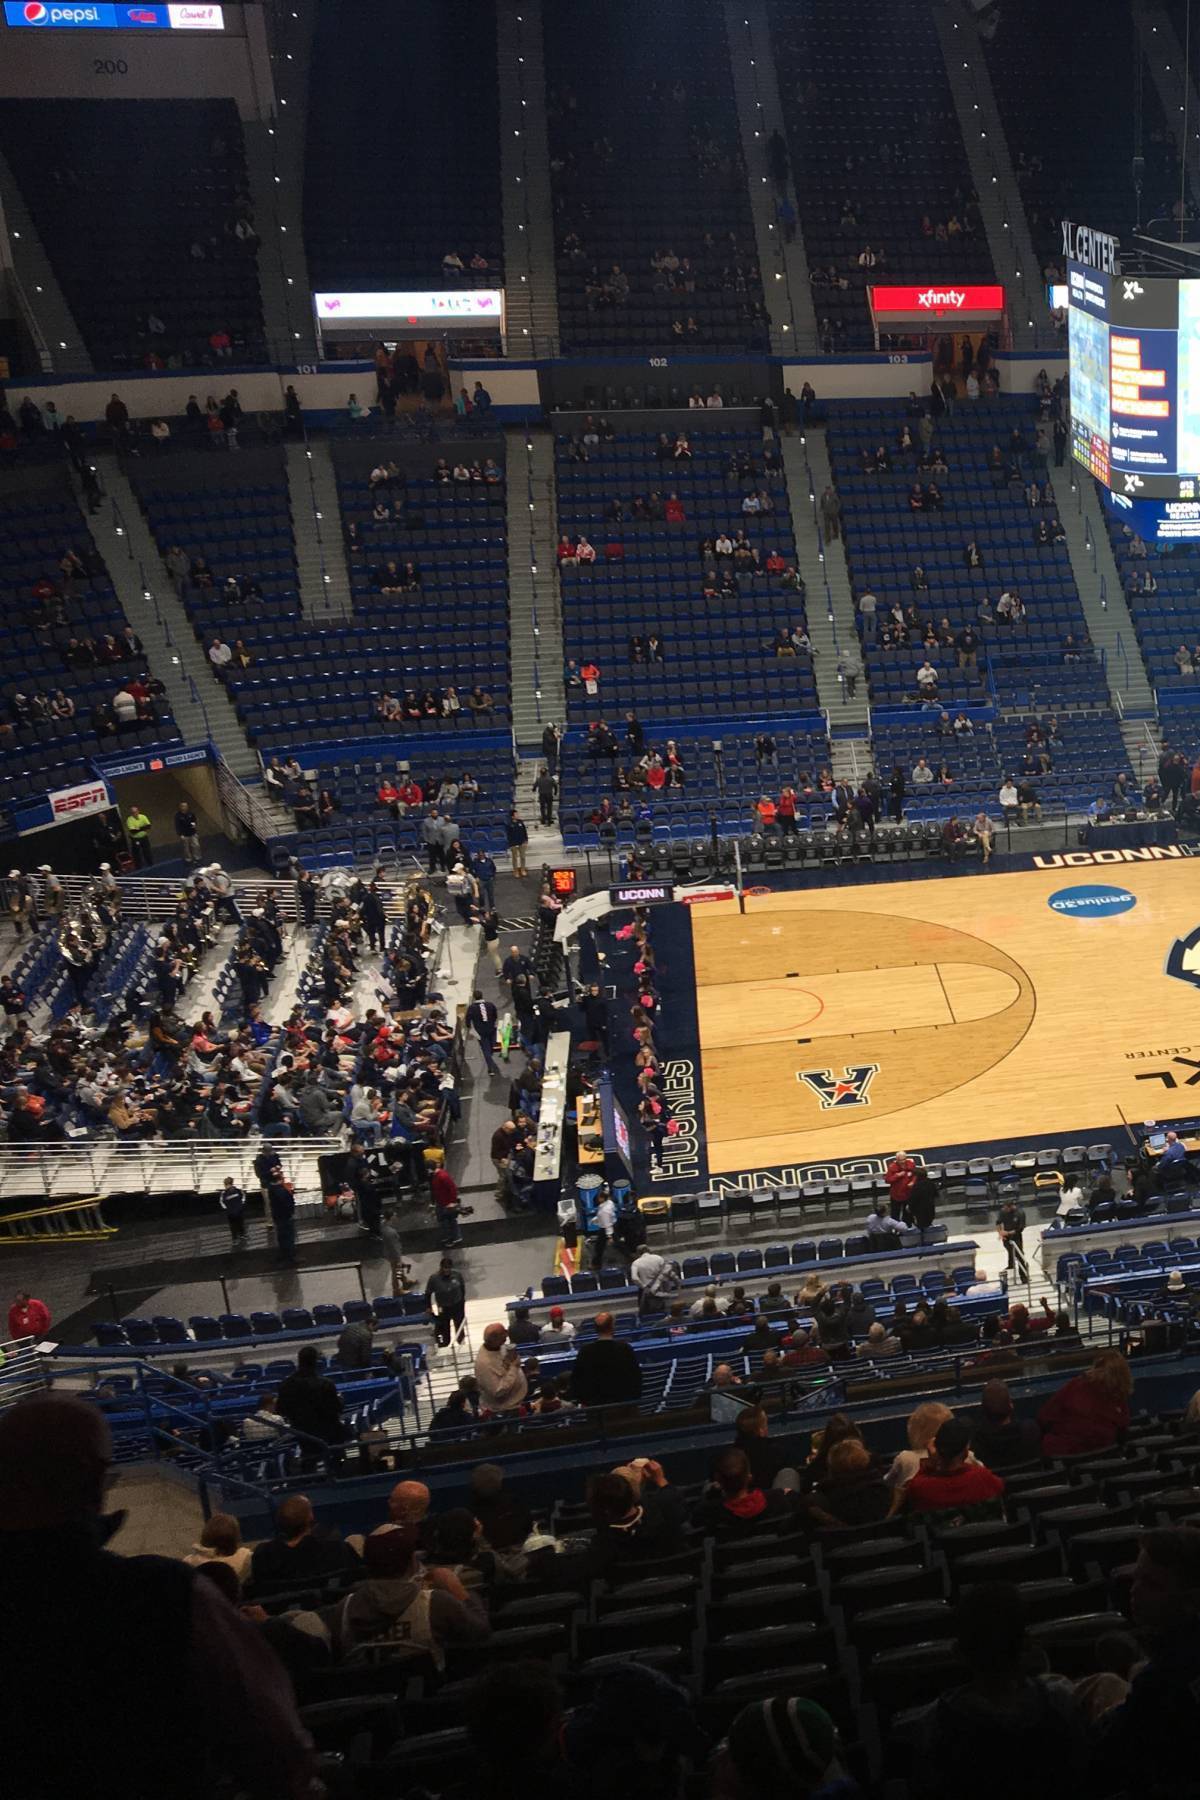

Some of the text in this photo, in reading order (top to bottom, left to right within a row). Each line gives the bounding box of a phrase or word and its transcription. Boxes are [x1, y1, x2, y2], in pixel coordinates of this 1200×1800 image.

[50, 7, 98, 24] pepsi
[93, 59, 129, 75] 200
[1061, 221, 1117, 276] XL CENTER
[918, 289, 966, 308] xfinity
[649, 357, 668, 368] 102
[888, 354, 909, 365] 103
[296, 365, 318, 374] 101
[53, 788, 106, 815] ESPN
[1032, 846, 1183, 870] UCONN
[555, 880, 570, 891] 30
[618, 888, 665, 901] UCONN
[1124, 1047, 1192, 1059] CENTER
